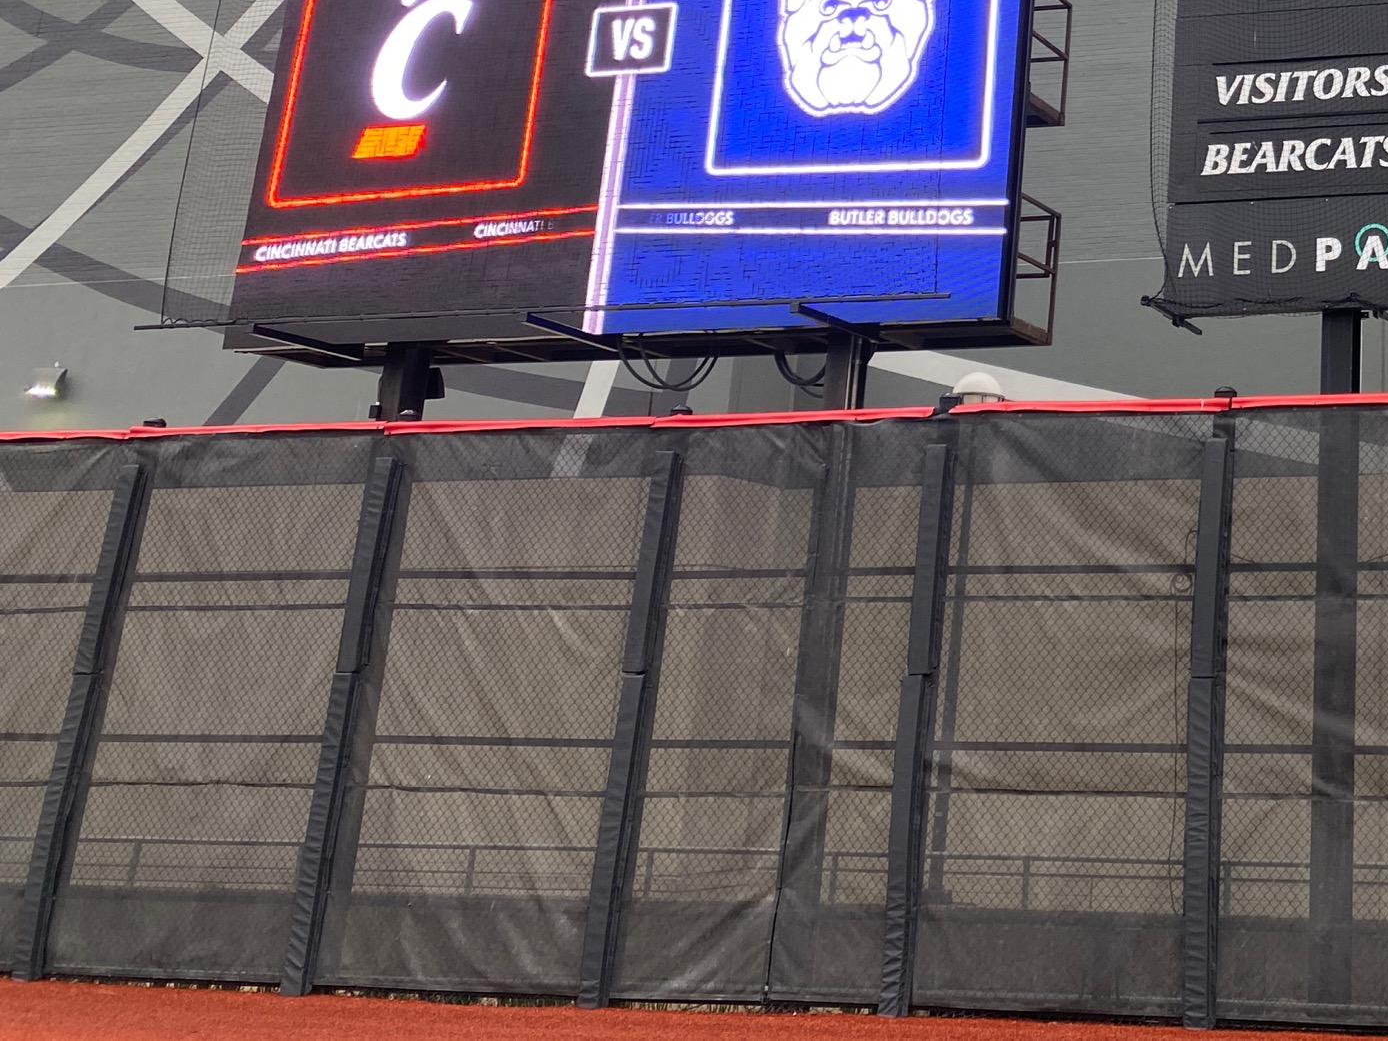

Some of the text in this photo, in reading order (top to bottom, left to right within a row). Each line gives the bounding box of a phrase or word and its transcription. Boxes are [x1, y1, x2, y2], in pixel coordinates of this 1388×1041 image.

[611, 16, 653, 61] VS
[666, 211, 734, 225] BULLDOGS
[828, 209, 886, 225] BUTLER
[887, 209, 974, 225] BULLDOGS
[474, 221, 545, 239] CINCINNATI
[255, 233, 407, 262] CINCINNATI BEARCATS
